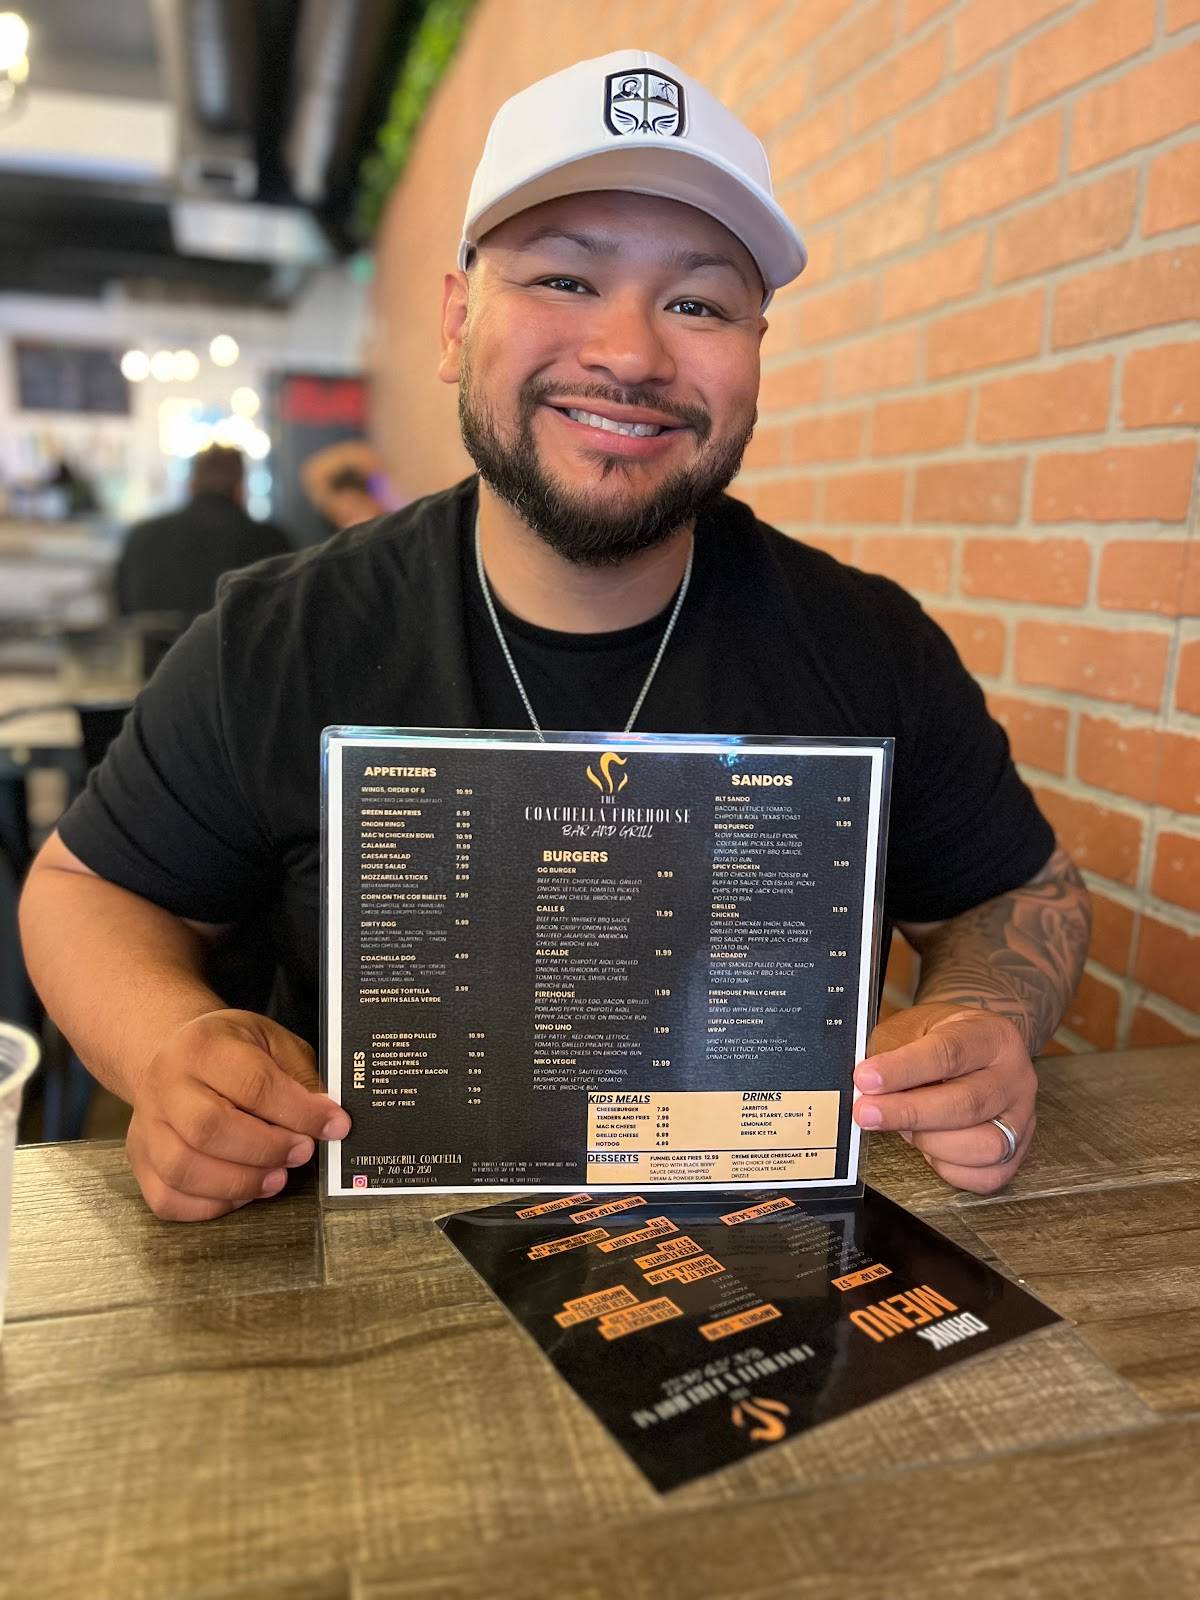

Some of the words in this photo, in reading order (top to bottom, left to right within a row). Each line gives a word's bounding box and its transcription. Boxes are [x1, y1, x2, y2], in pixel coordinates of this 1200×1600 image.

[364, 766, 437, 777] APPETIZERS
[731, 774, 793, 786] SANDOS
[601, 795, 615, 804] THE
[525, 806, 606, 822] COACHELLA
[612, 808, 691, 823] FIREHOUSE
[562, 824, 590, 837] BAR
[591, 825, 616, 837] AND
[619, 825, 654, 839] GRILL
[543, 850, 609, 862] BURGERS
[353, 1051, 365, 1089] FRIES
[588, 1095, 614, 1103] KIDS
[615, 1095, 651, 1103] MEALS
[742, 1092, 782, 1101] DRINKS
[587, 1154, 639, 1162] DESSERTS
[599, 1206, 613, 1216] TAP
[753, 1200, 790, 1215] DOMESTIC
[651, 1219, 669, 1228] $18
[636, 1225, 674, 1240] MIMOSAS
[609, 1235, 638, 1248] FLIGHT
[662, 1239, 692, 1252] $17.99
[677, 1245, 699, 1256] BEER
[645, 1251, 678, 1266] FLIGHTS
[675, 1257, 714, 1273] CHAVELA
[697, 1264, 721, 1276] MAKE
[873, 1266, 888, 1275] ON
[860, 1271, 877, 1281] TAP
[850, 1284, 959, 1342] MENU
[916, 1312, 990, 1350] DRINK
